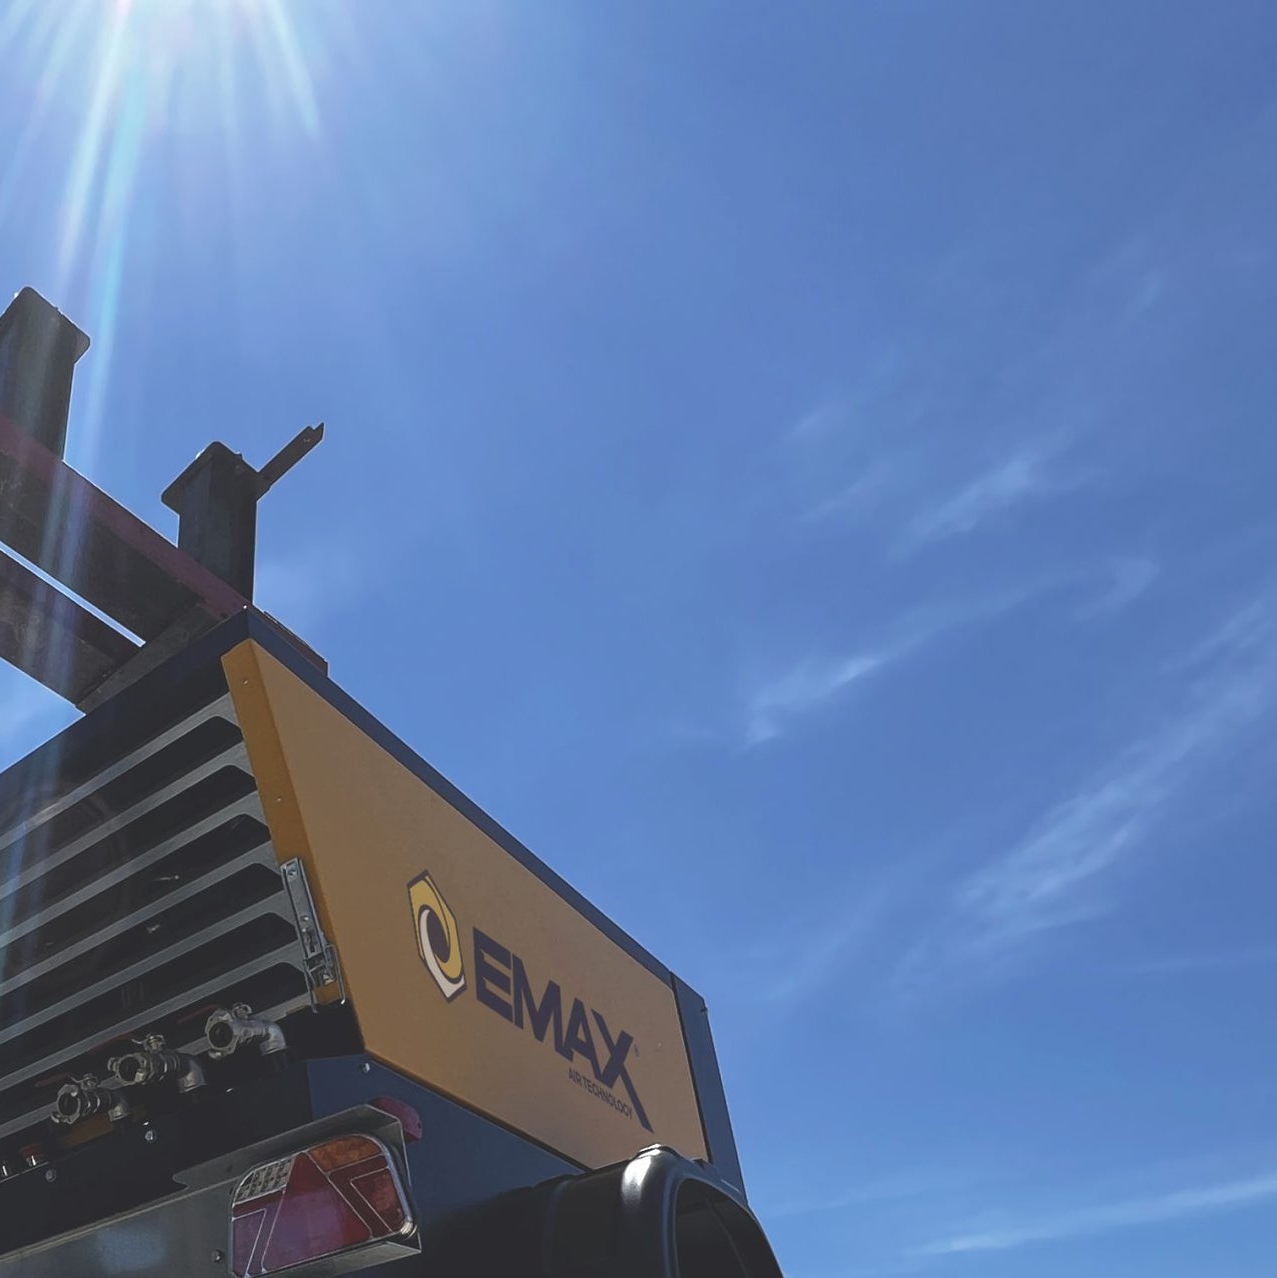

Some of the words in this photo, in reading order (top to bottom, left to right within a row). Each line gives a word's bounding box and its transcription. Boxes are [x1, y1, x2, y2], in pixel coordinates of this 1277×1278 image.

[473, 926, 654, 1134] EMAX
[568, 1068, 583, 1087] AIR
[582, 1076, 633, 1119] TECHNOLOGY
